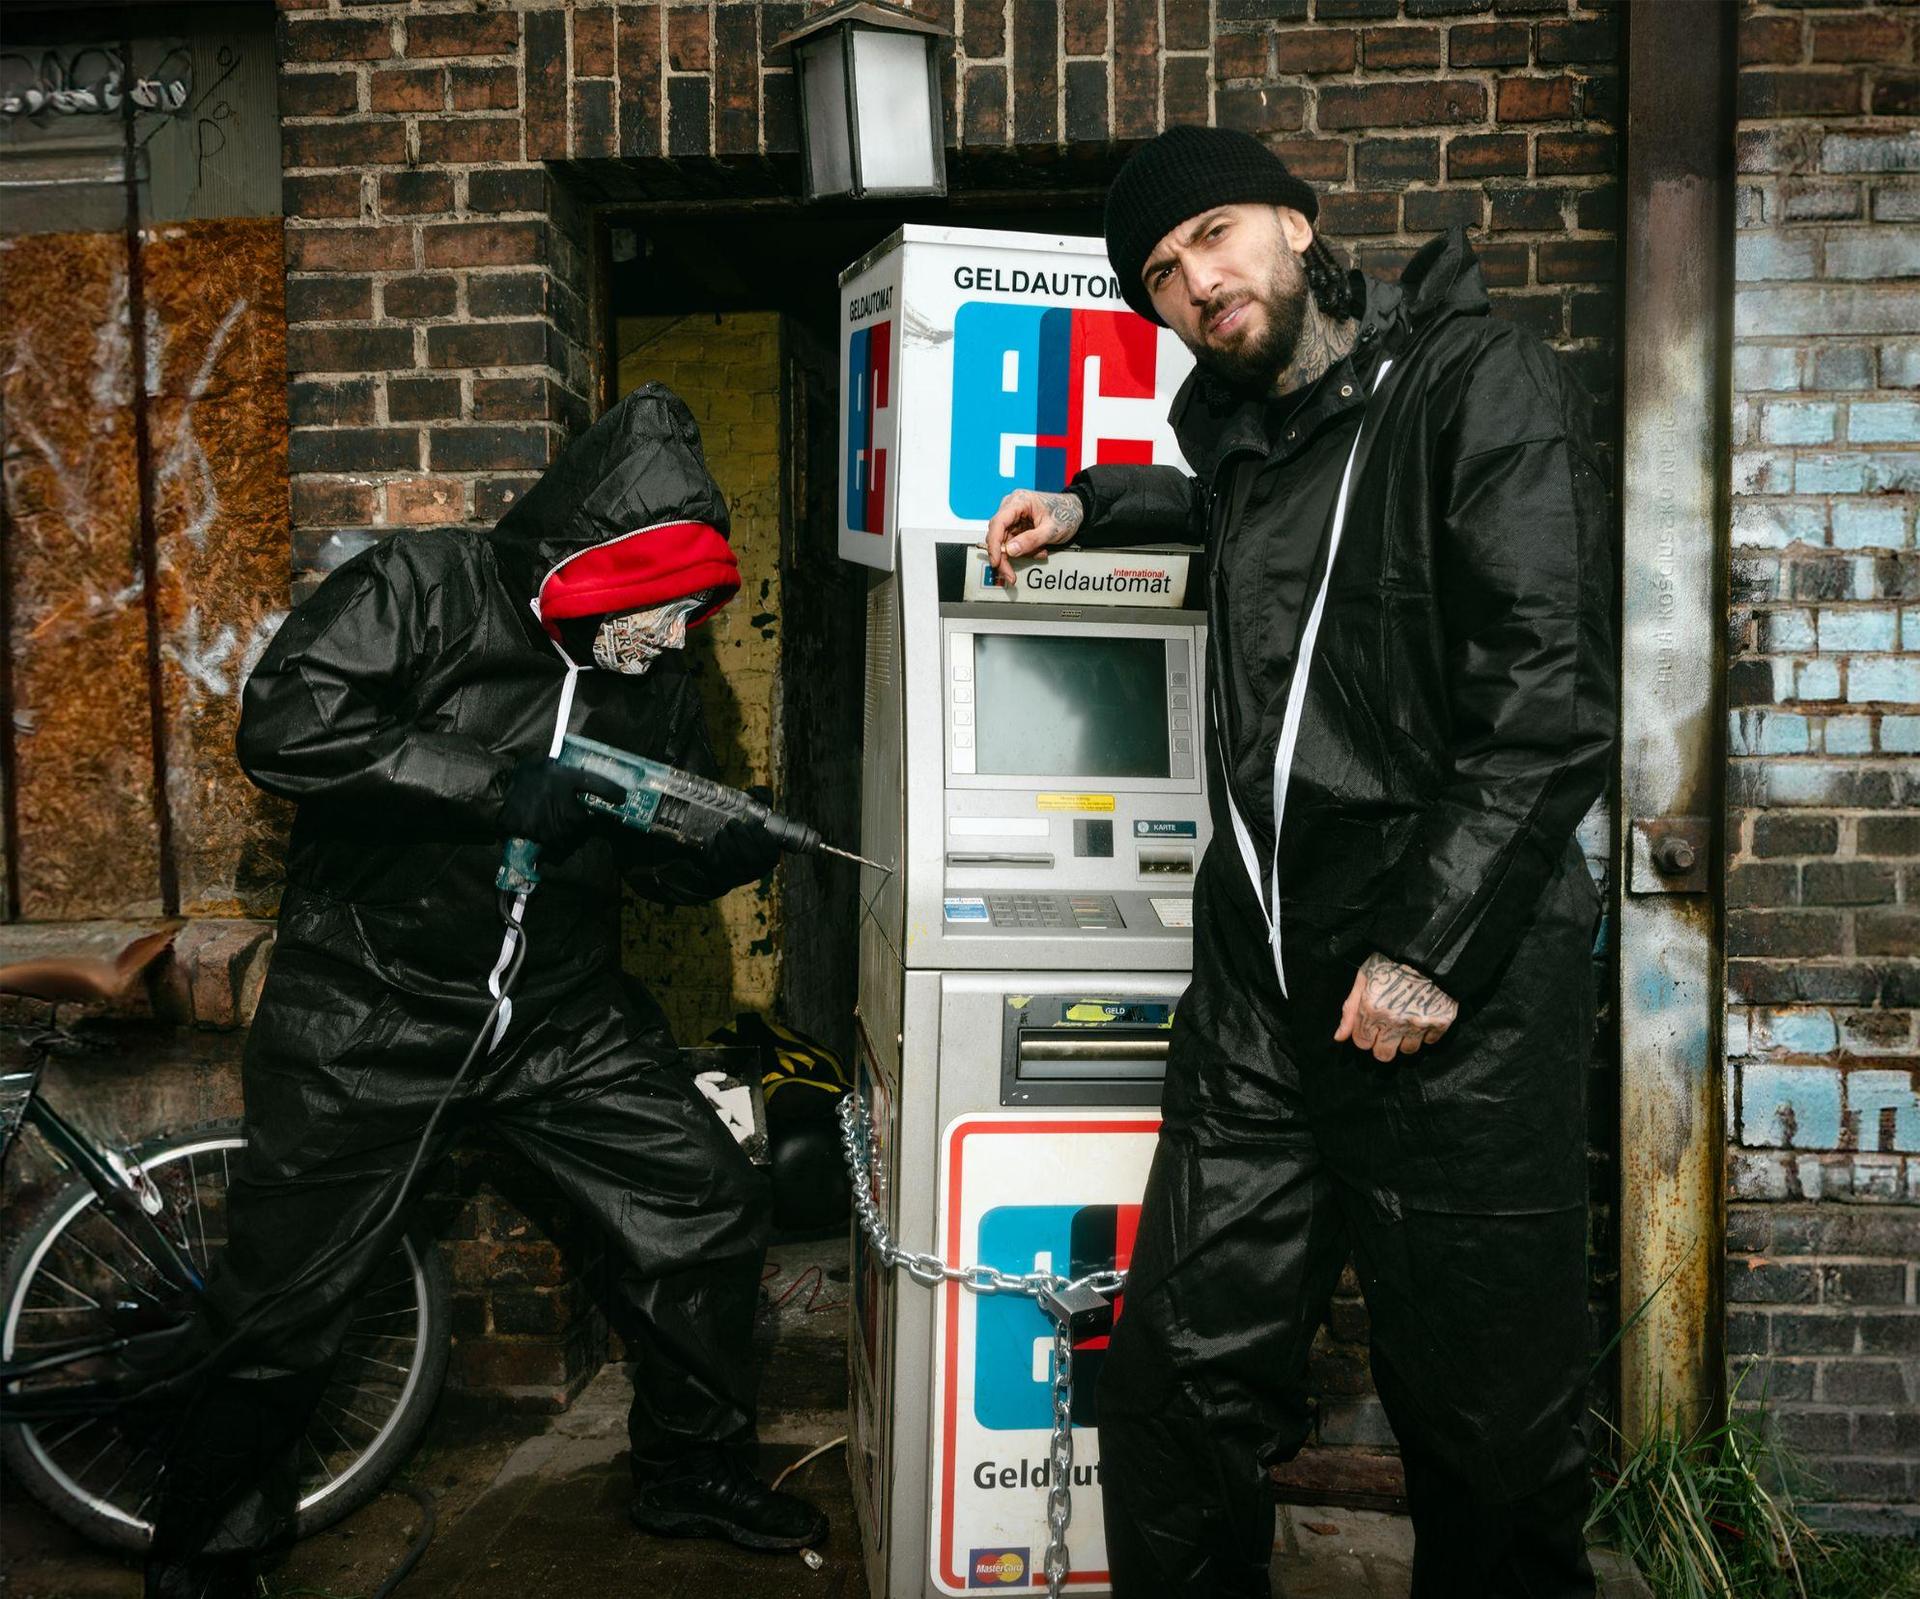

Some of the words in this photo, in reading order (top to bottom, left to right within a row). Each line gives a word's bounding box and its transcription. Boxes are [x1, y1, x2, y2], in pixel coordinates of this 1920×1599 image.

[849, 286, 893, 322] GELDAUTOMAT
[1113, 567, 1165, 578] International
[1026, 567, 1171, 594] Geldautomat
[1105, 1007, 1125, 1015] GELD
[976, 1562, 1024, 1574] MasterCard
